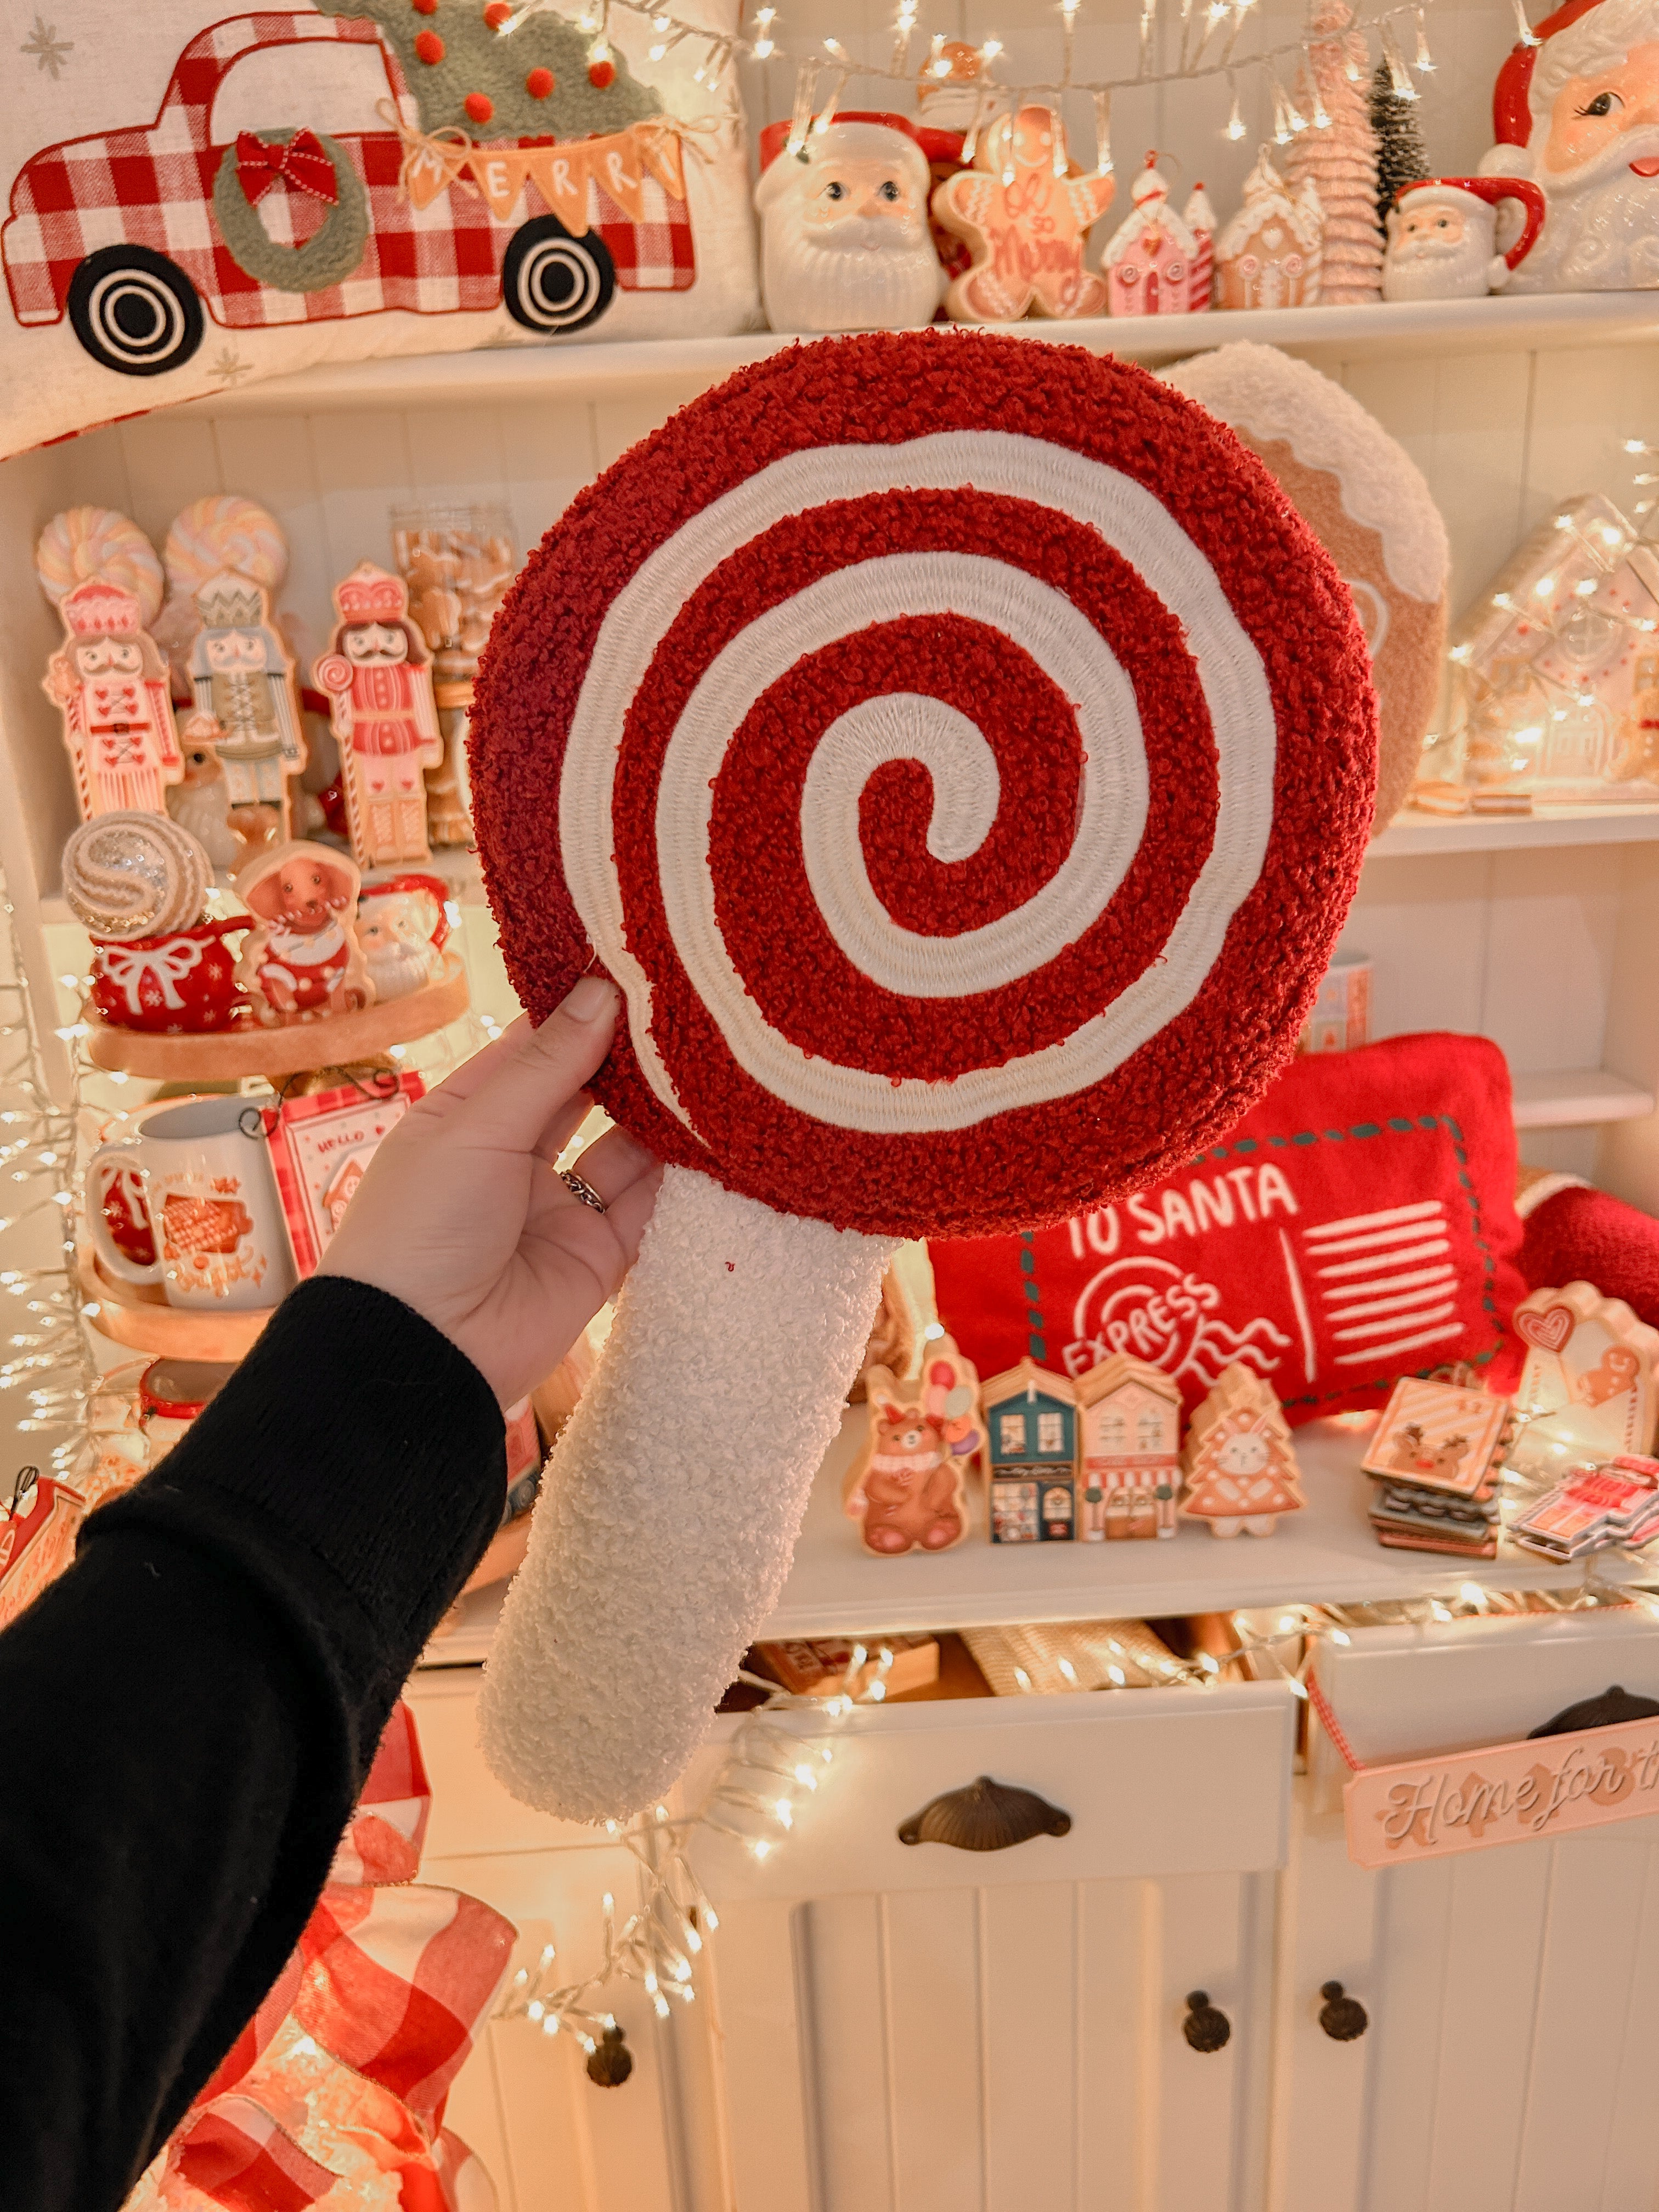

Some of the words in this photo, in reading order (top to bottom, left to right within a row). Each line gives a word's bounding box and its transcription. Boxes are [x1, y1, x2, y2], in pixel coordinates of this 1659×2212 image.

[317, 1130, 365, 1153] HELLO
[1127, 1162, 1299, 1244] SANTA
[1062, 1272, 1222, 1380] EXPRESS
[1384, 1773, 1539, 1845] Home
[1532, 1747, 1625, 1833] for
